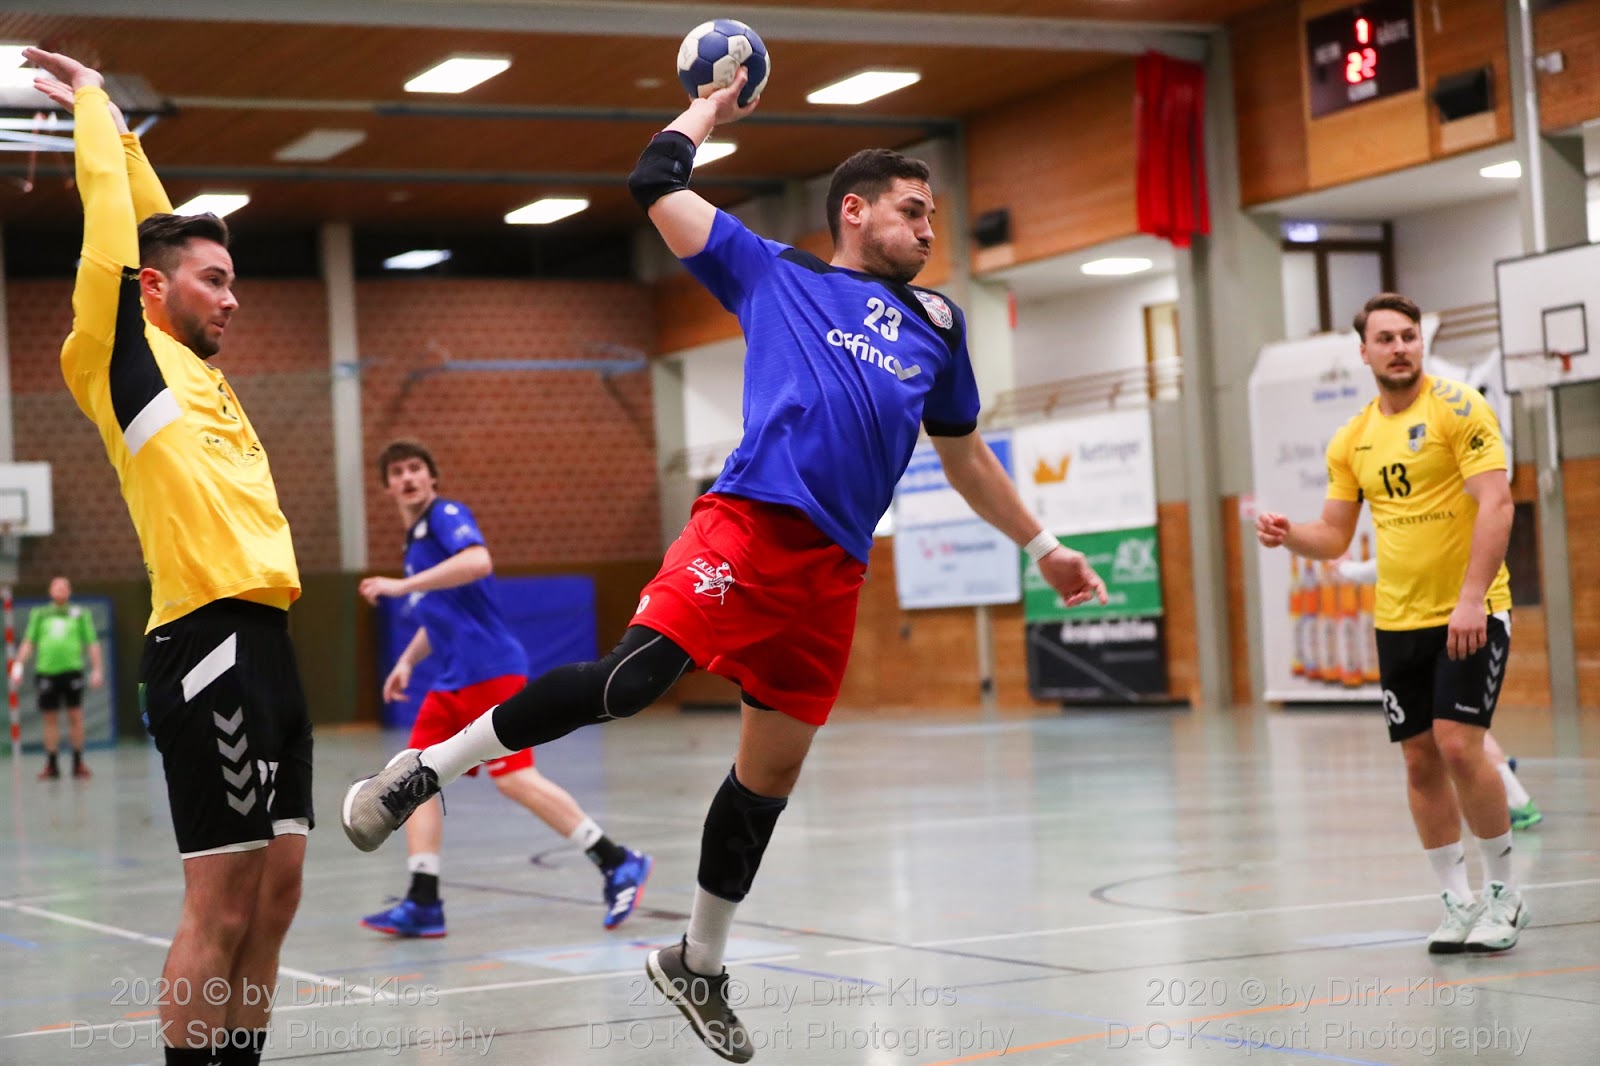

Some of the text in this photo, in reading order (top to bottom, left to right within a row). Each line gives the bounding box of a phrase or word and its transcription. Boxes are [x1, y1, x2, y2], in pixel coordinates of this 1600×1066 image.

[1355, 18, 1370, 44] 1
[1346, 47, 1377, 83] 22
[863, 297, 902, 342] 23
[1379, 462, 1411, 499] 13
